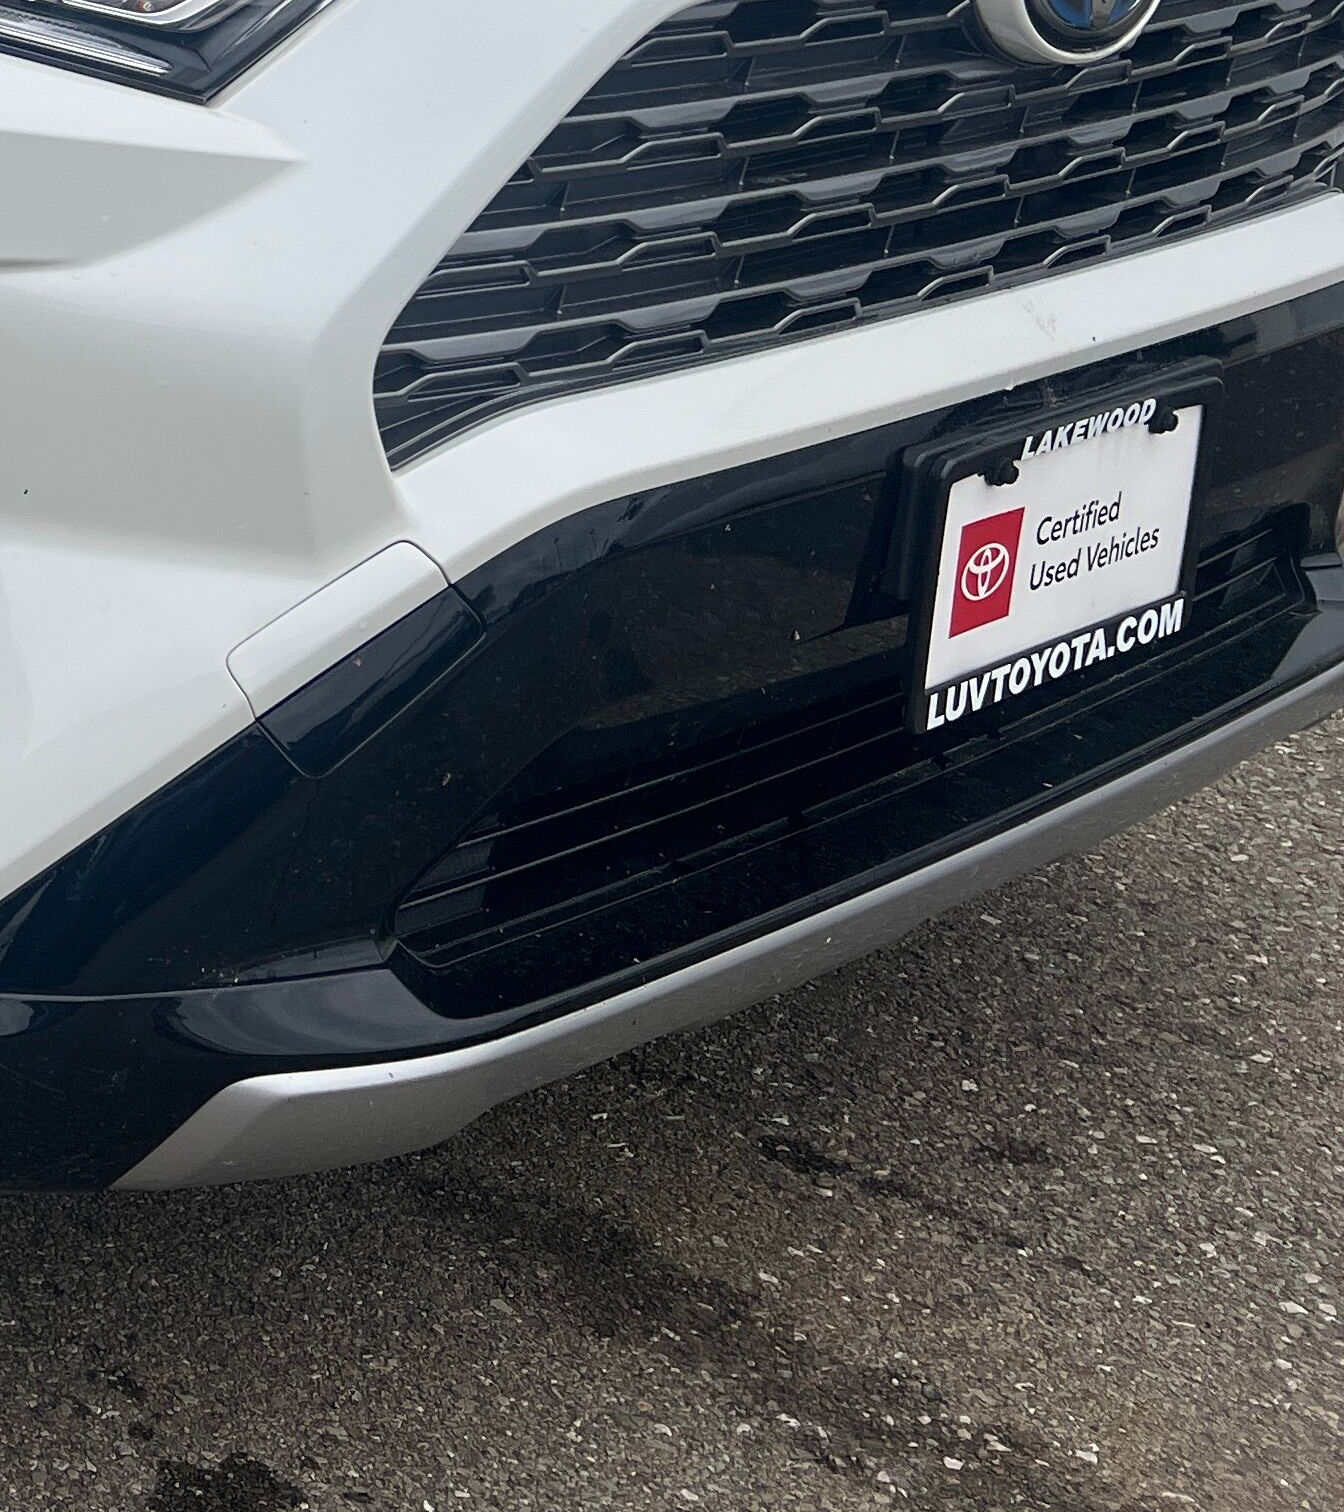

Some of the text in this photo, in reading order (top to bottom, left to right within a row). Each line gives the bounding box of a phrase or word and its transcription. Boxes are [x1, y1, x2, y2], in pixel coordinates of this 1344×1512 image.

[1021, 399, 1157, 460] LAKEWOOD
[1037, 491, 1123, 546] Certified
[1030, 526, 1160, 590] Used Vehicles
[926, 599, 1185, 731] LUVTOYOTA.COM
